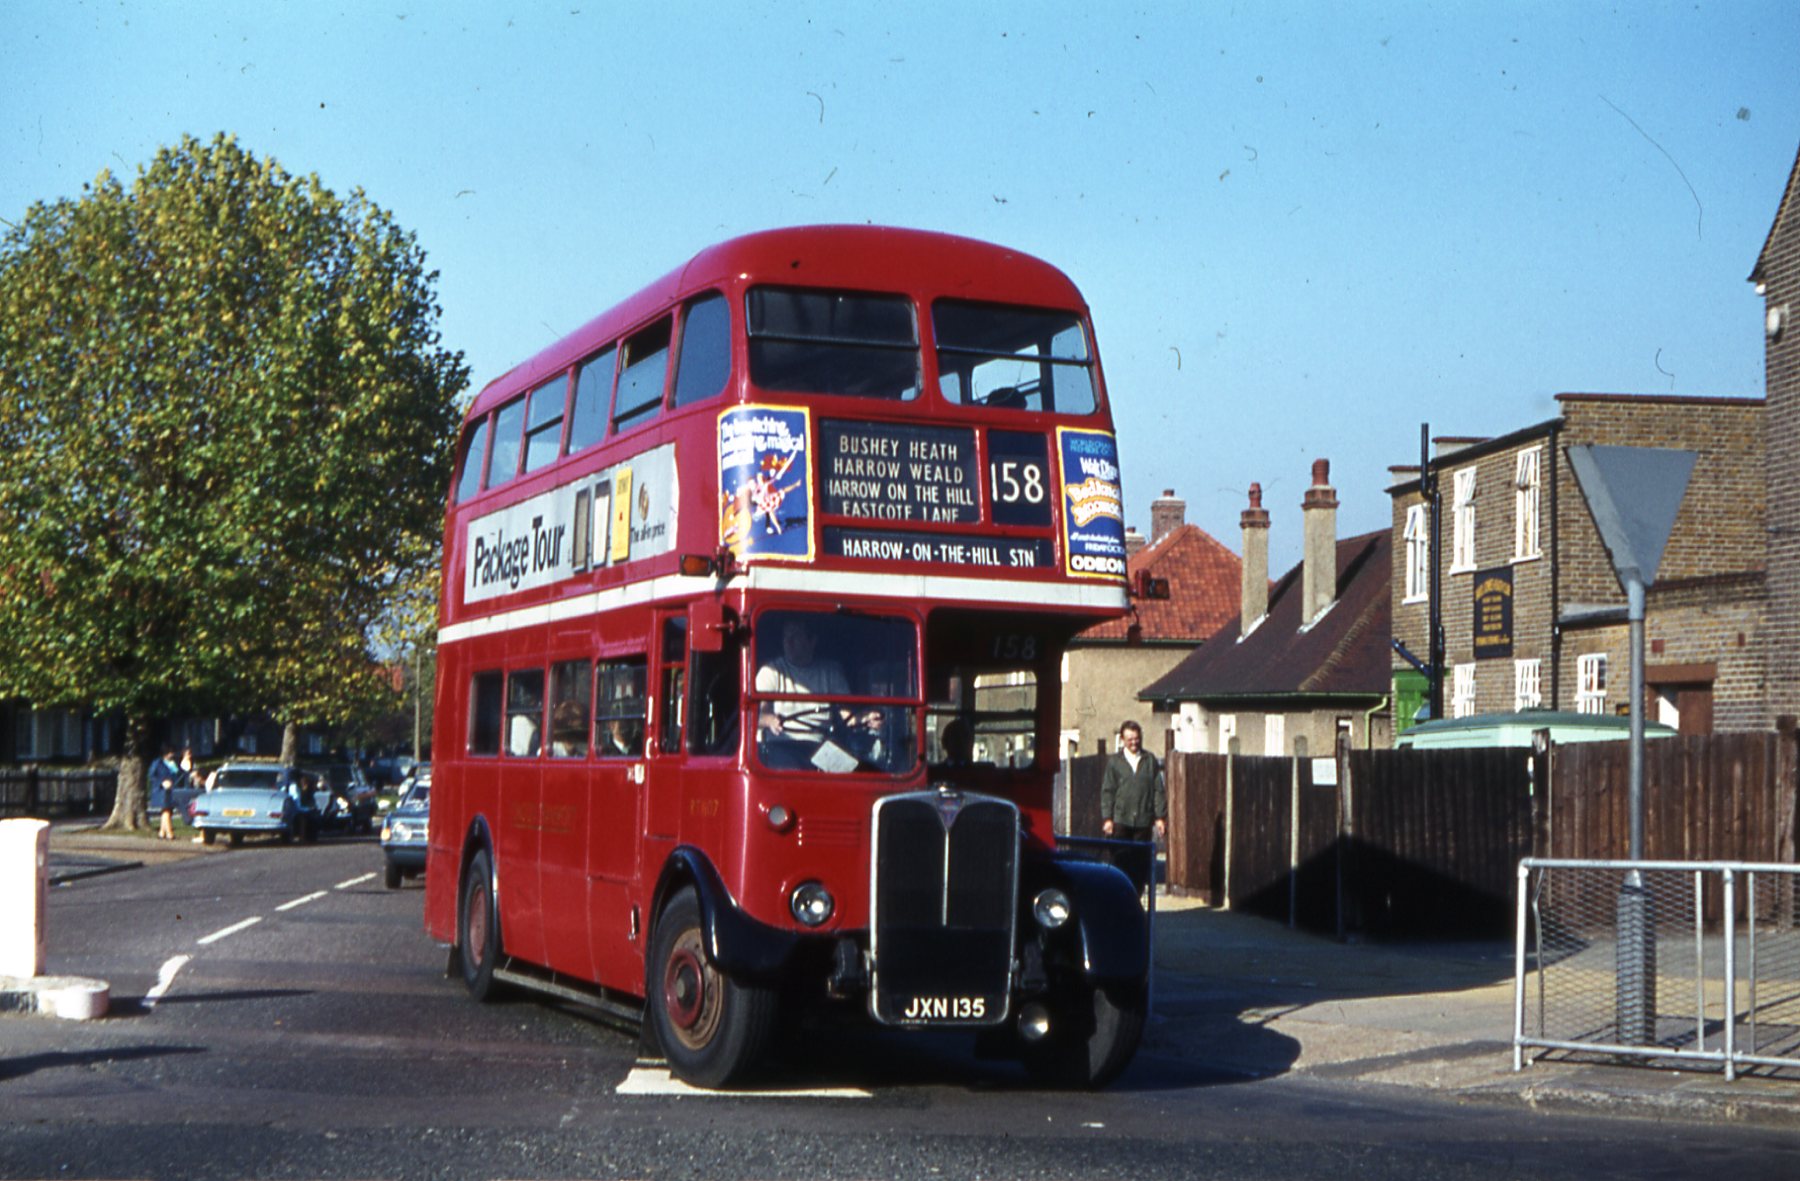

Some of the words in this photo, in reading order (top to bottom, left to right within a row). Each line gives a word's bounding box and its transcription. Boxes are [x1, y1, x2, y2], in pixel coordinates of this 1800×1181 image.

[839, 435, 899, 457] BUSHEY
[909, 441, 958, 461] HEATH
[833, 457, 900, 478] HARROW
[909, 463, 963, 484] WEALD
[991, 462, 1044, 503] 158
[826, 480, 880, 498] HARROW
[887, 482, 907, 500] ON
[914, 485, 940, 503] THE
[946, 487, 975, 505] HILL
[473, 528, 528, 589] Package
[532, 515, 565, 573] Tour
[1009, 549, 1035, 567] STN
[1071, 554, 1126, 574] ODEON
[993, 634, 1036, 660] 158
[904, 997, 948, 1018] JXN
[952, 997, 985, 1018] 135
